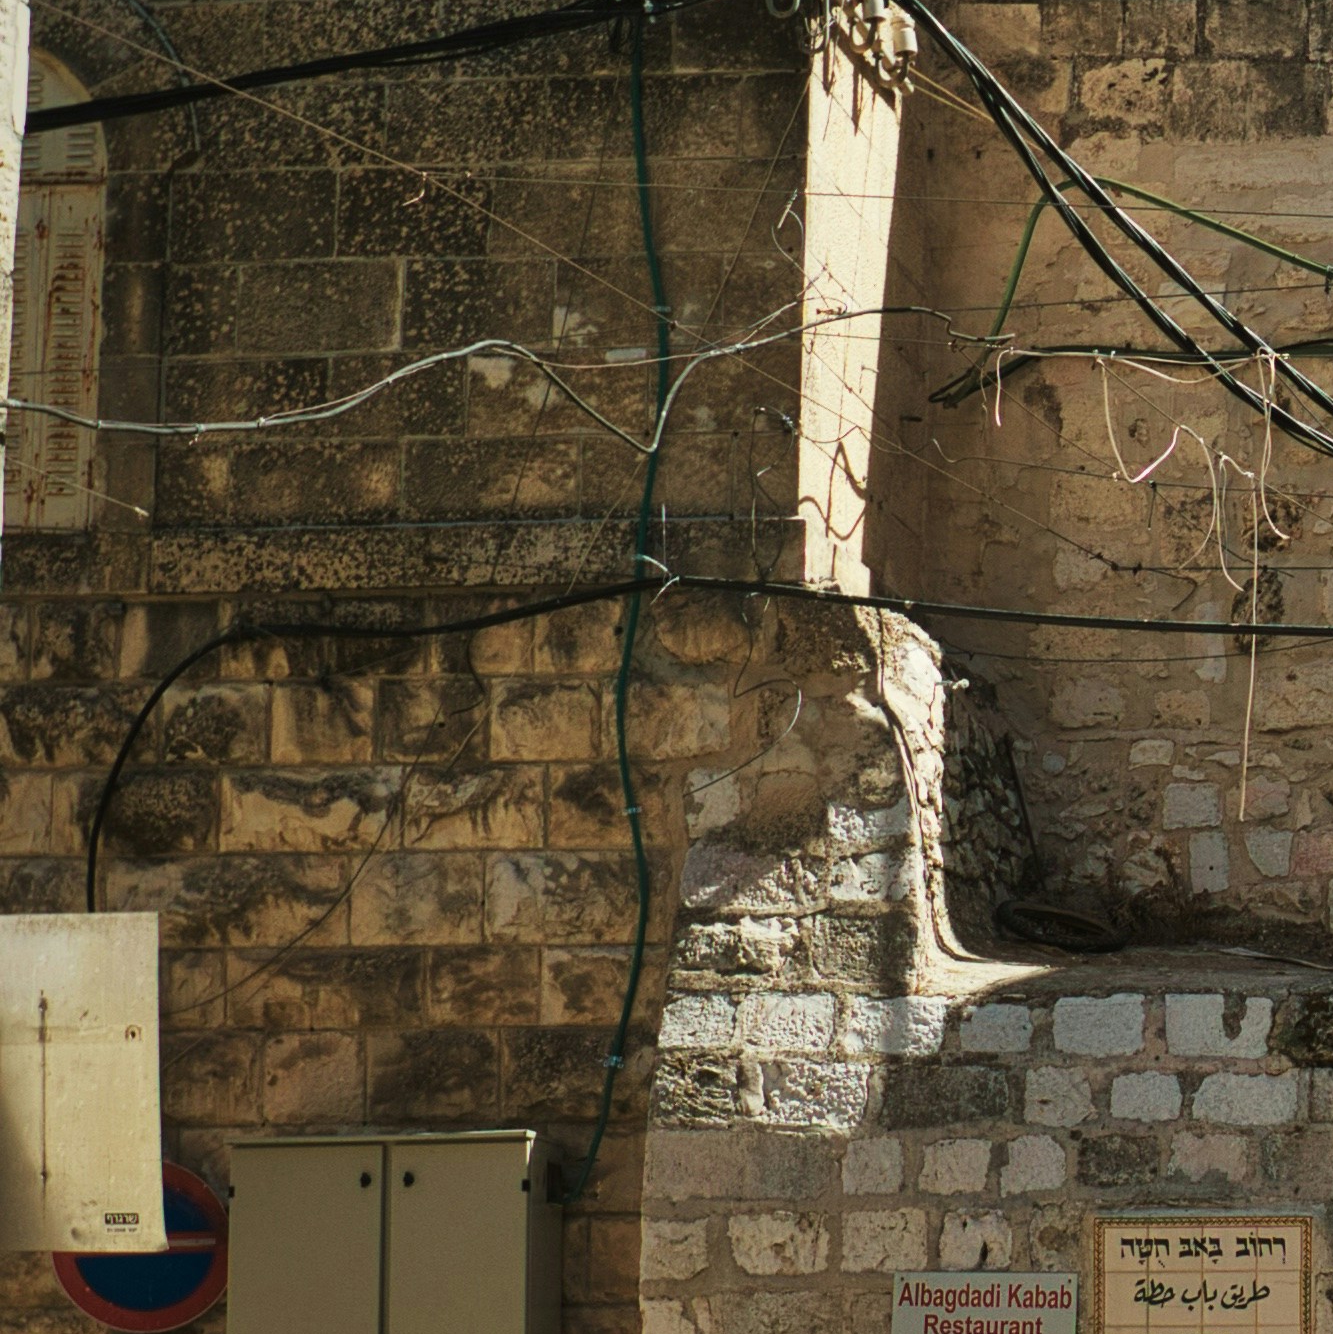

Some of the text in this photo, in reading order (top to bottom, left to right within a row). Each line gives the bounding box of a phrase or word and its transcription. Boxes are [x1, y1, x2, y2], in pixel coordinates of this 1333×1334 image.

[898, 1282, 1072, 1314] Albagdadi Kabab
[1134, 1278, 1271, 1312] طريق باب حطة
